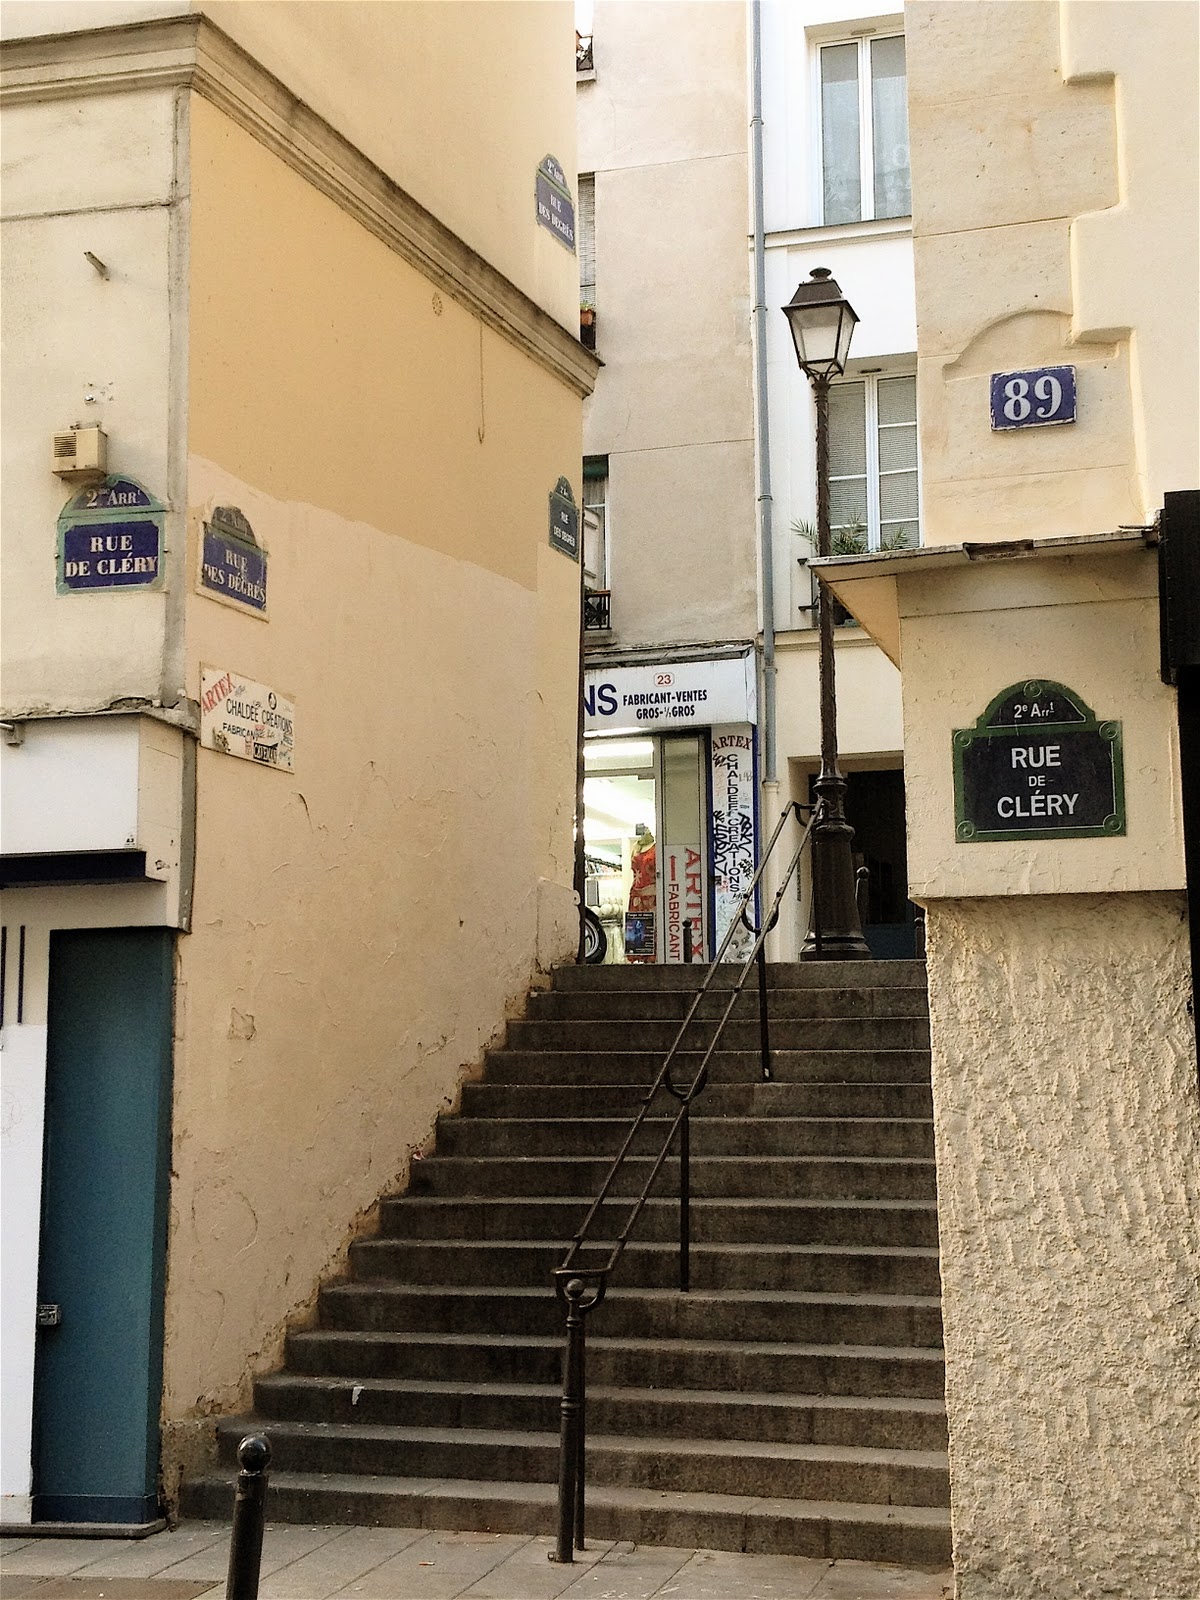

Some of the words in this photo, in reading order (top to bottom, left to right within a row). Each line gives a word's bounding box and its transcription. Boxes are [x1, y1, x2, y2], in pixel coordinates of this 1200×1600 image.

[538, 201, 551, 221] DES
[550, 194, 562, 213] RUE
[1003, 375, 1062, 421] 89
[90, 535, 133, 553] RUE
[65, 560, 91, 577] DE
[96, 552, 158, 576] CLÉRY
[225, 548, 248, 571] RUE
[657, 674, 672, 685] 23
[201, 673, 236, 716] ARTEX
[623, 689, 708, 706] FABRICANT-VENTES
[1013, 703, 1028, 718] 2e
[712, 735, 752, 751] ARTEX
[1011, 745, 1061, 769] RUE
[1028, 775, 1046, 787] DE
[997, 789, 1079, 818] CLÉRY
[727, 817, 741, 894] CREATIONS
[668, 883, 680, 960] FABRICANT
